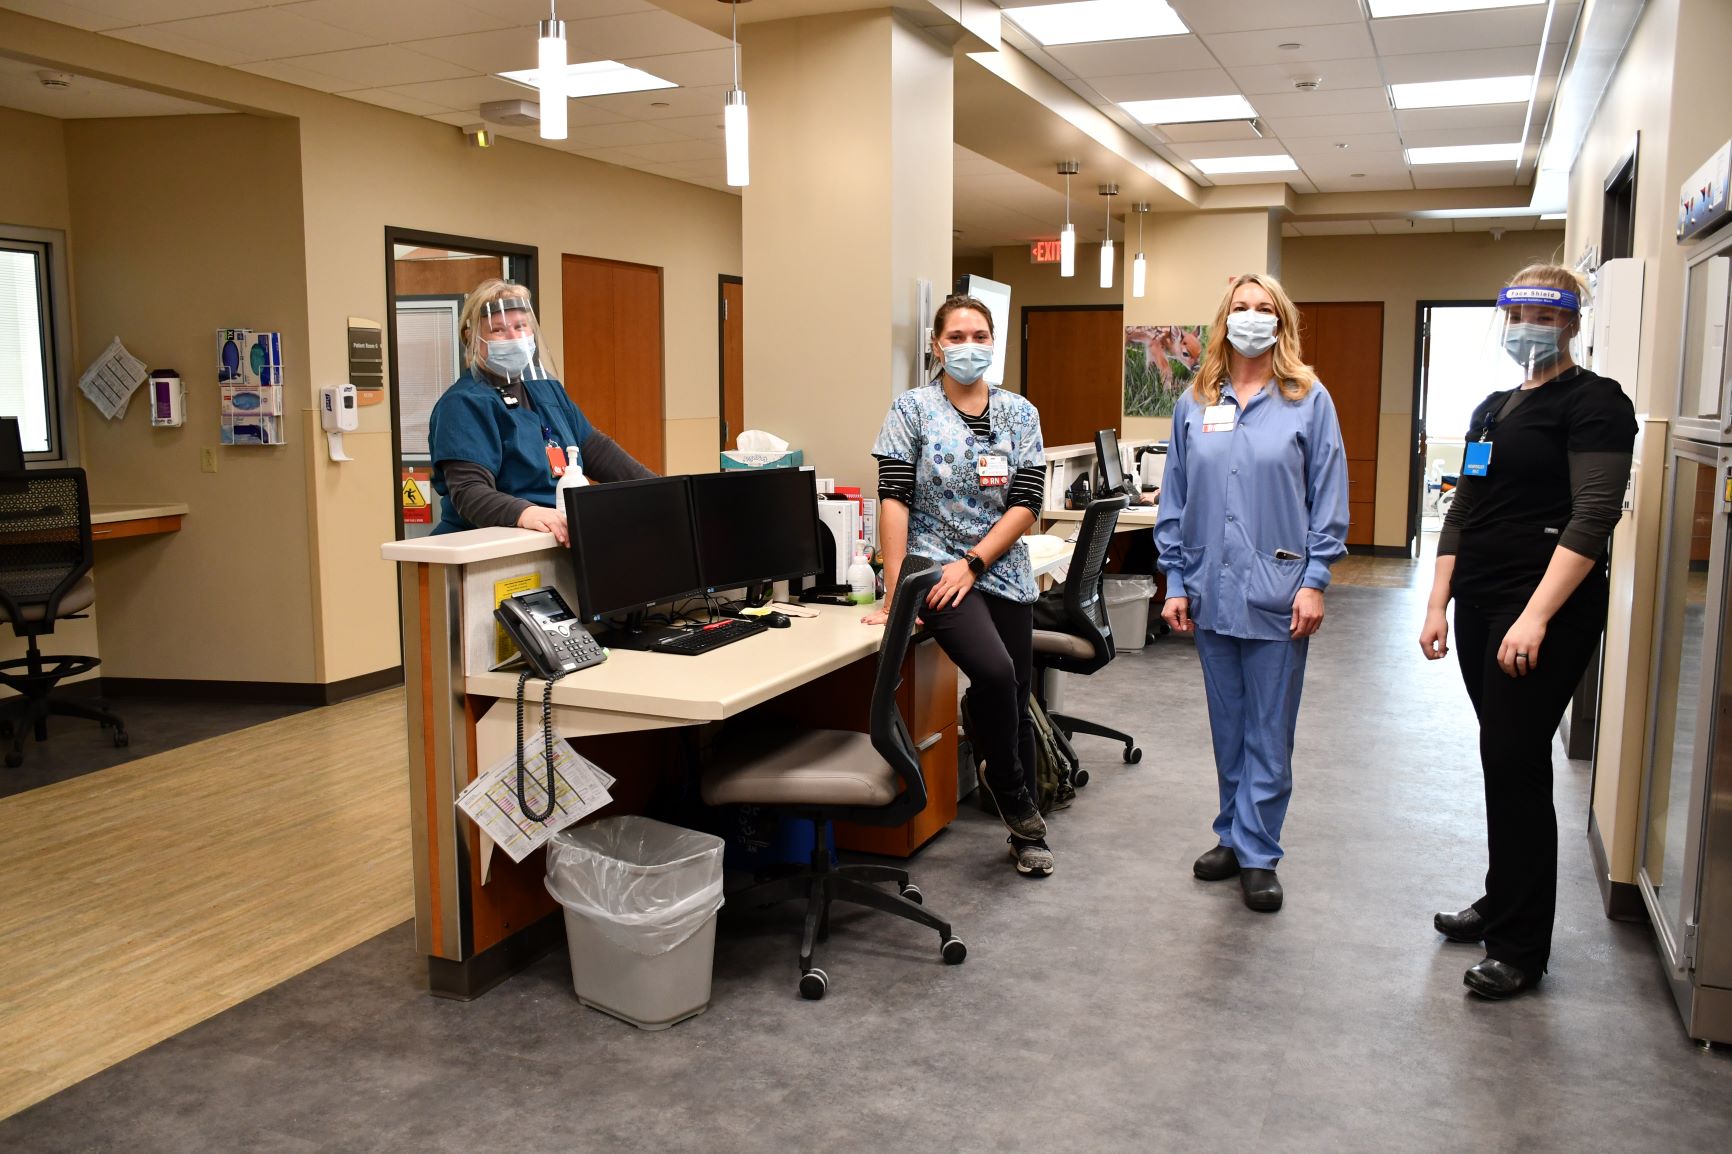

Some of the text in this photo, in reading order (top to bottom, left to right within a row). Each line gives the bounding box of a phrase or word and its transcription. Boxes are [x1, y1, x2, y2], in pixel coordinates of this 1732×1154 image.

[1037, 241, 1061, 262] EXIT
[1530, 290, 1555, 298] Shield
[990, 477, 1000, 485] RN
